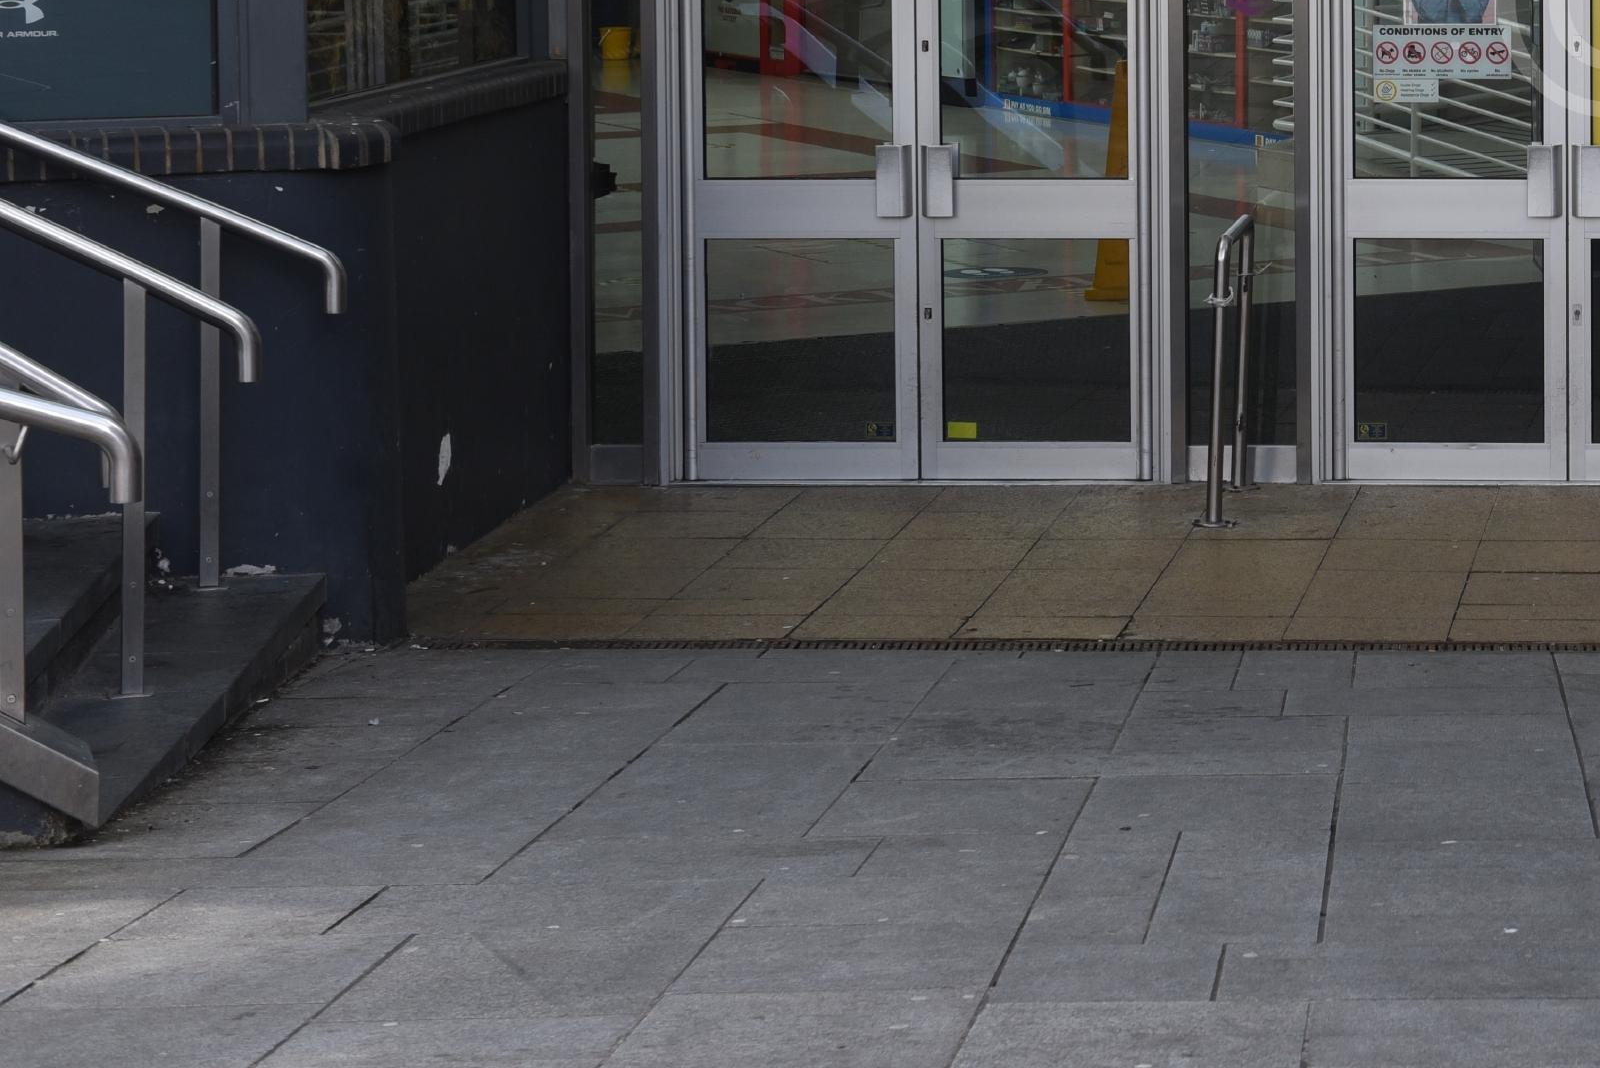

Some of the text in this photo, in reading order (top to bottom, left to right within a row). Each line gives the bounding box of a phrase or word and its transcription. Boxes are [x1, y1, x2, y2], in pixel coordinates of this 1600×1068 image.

[1379, 27, 1505, 36] CONDITIONS OF ENTRY
